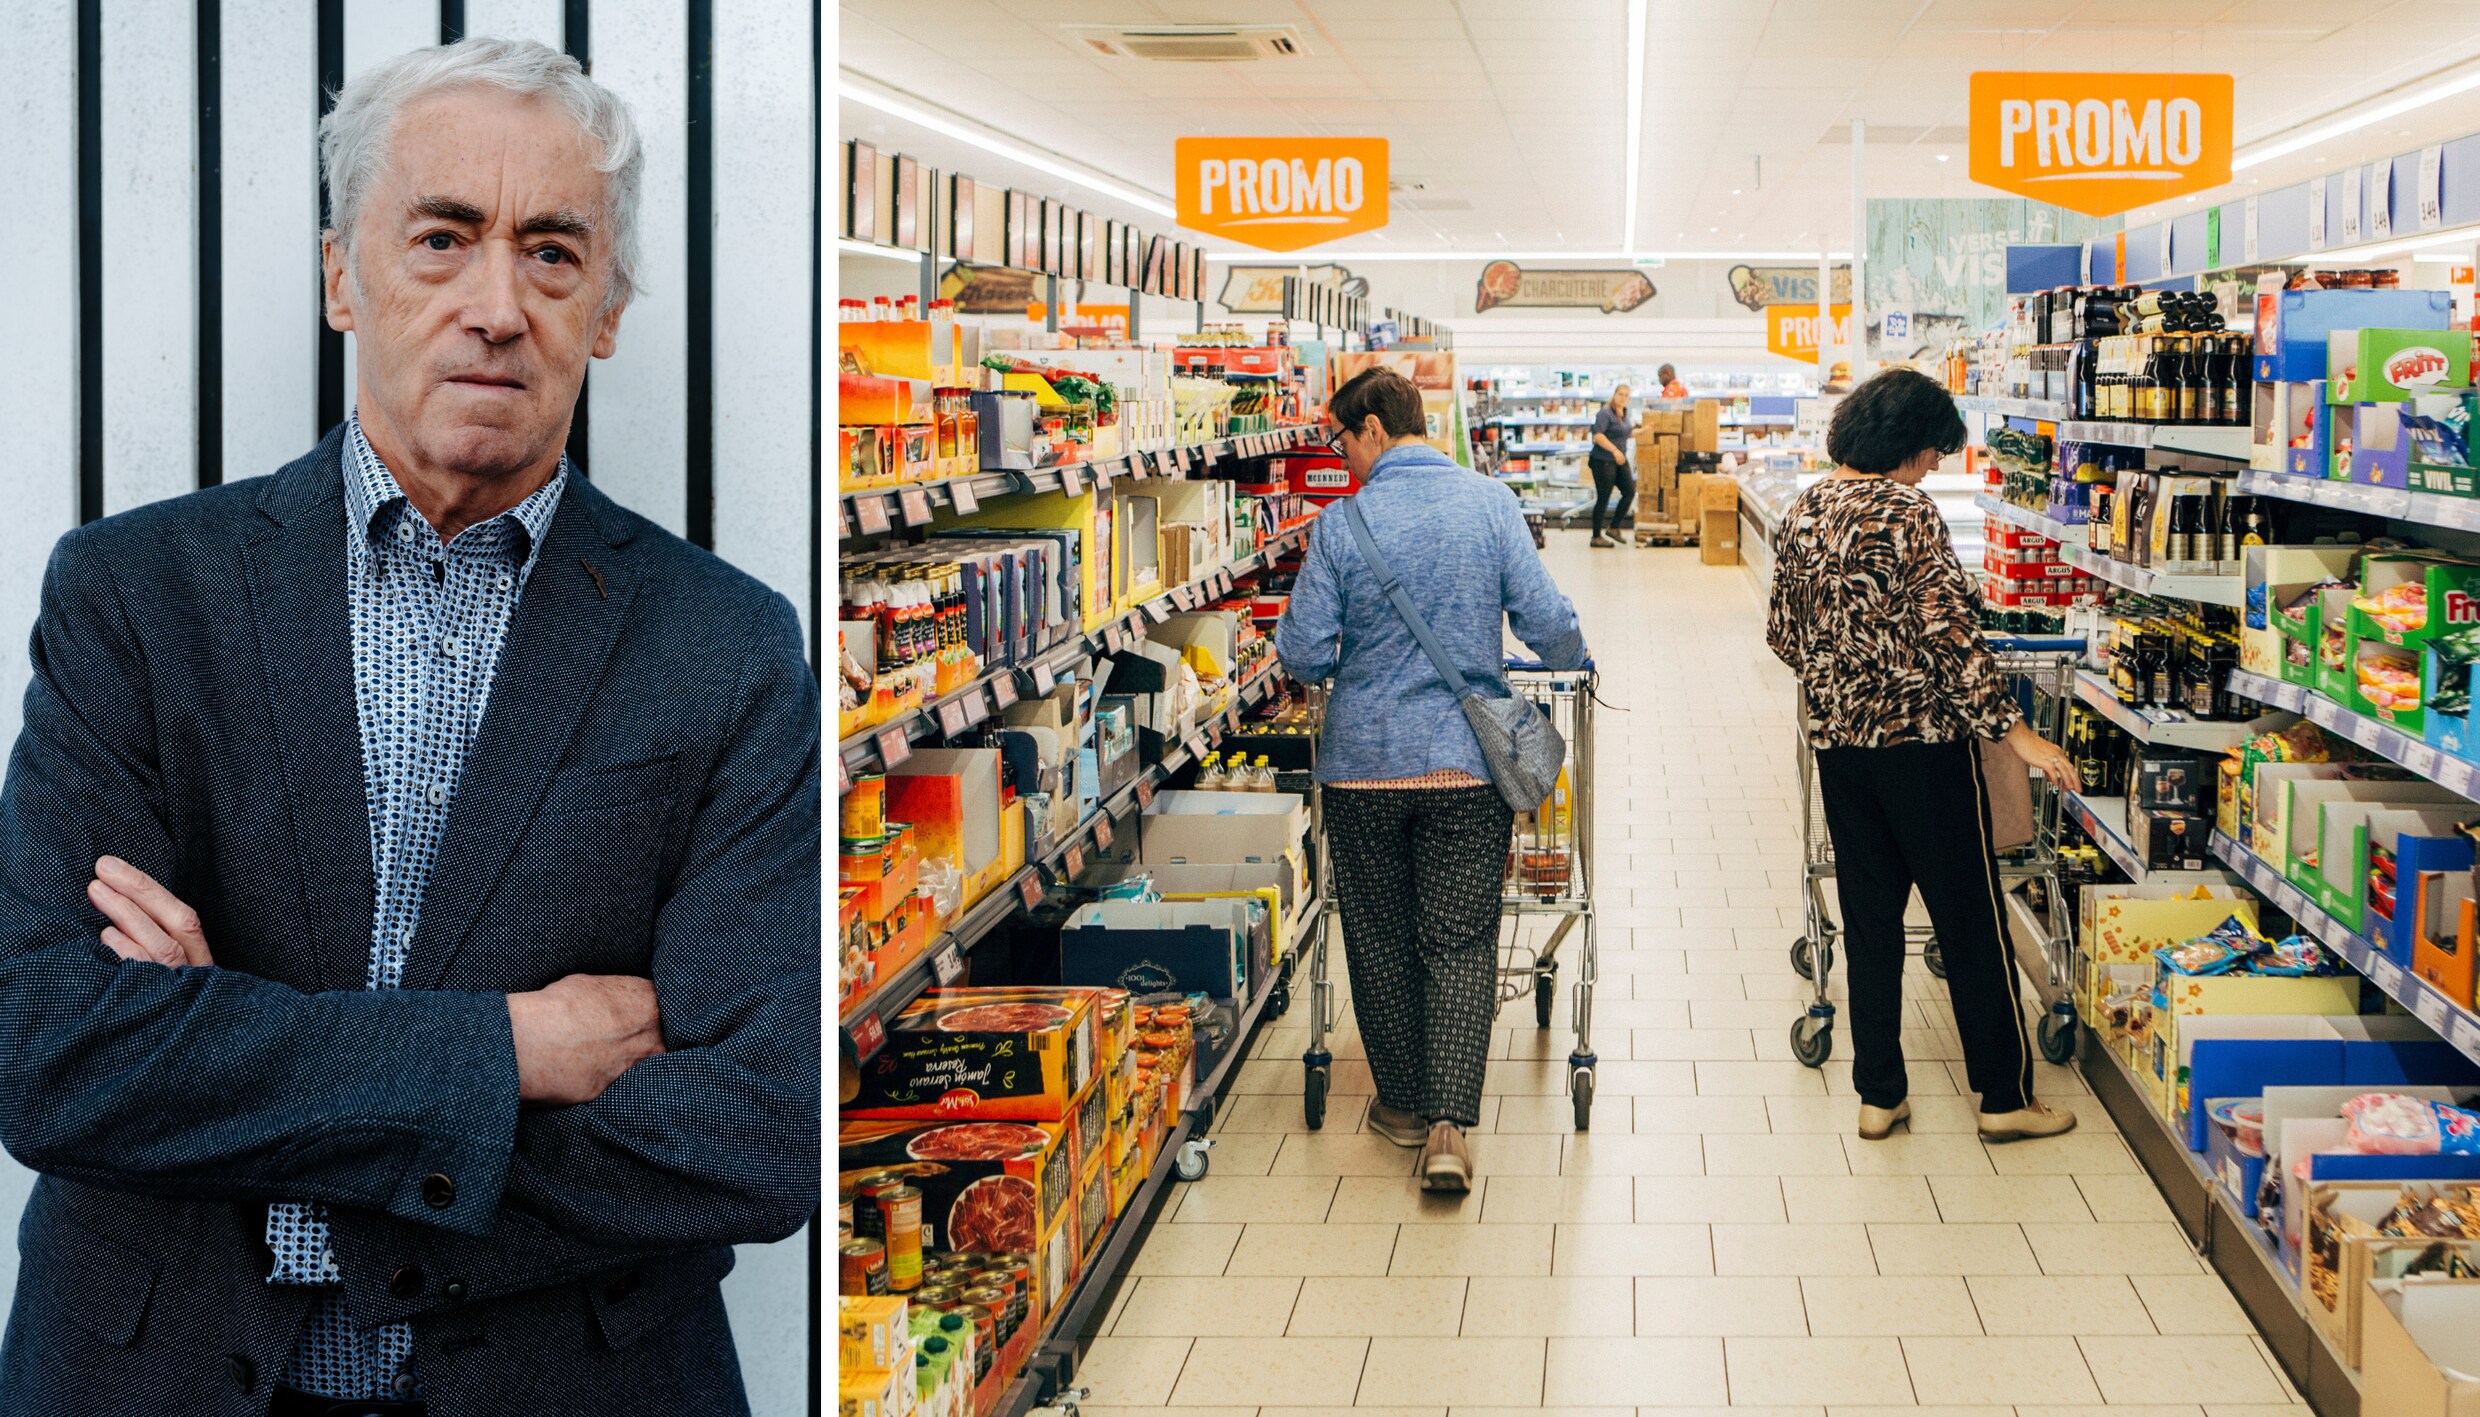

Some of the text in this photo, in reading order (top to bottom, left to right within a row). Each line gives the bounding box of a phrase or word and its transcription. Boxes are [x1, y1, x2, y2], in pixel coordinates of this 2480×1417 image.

[2000, 98, 2202, 168] PROMO
[1199, 158, 1365, 215] PROMO
[1935, 254, 2004, 287] VIS
[1523, 276, 1608, 299] CHARCUTERIE
[1772, 275, 1817, 300] VIS
[2424, 470, 2454, 492] VIVIL
[1140, 980, 1166, 988] delights
[909, 1062, 992, 1090] Jamón Serrano
[925, 1058, 968, 1073] Reserva
